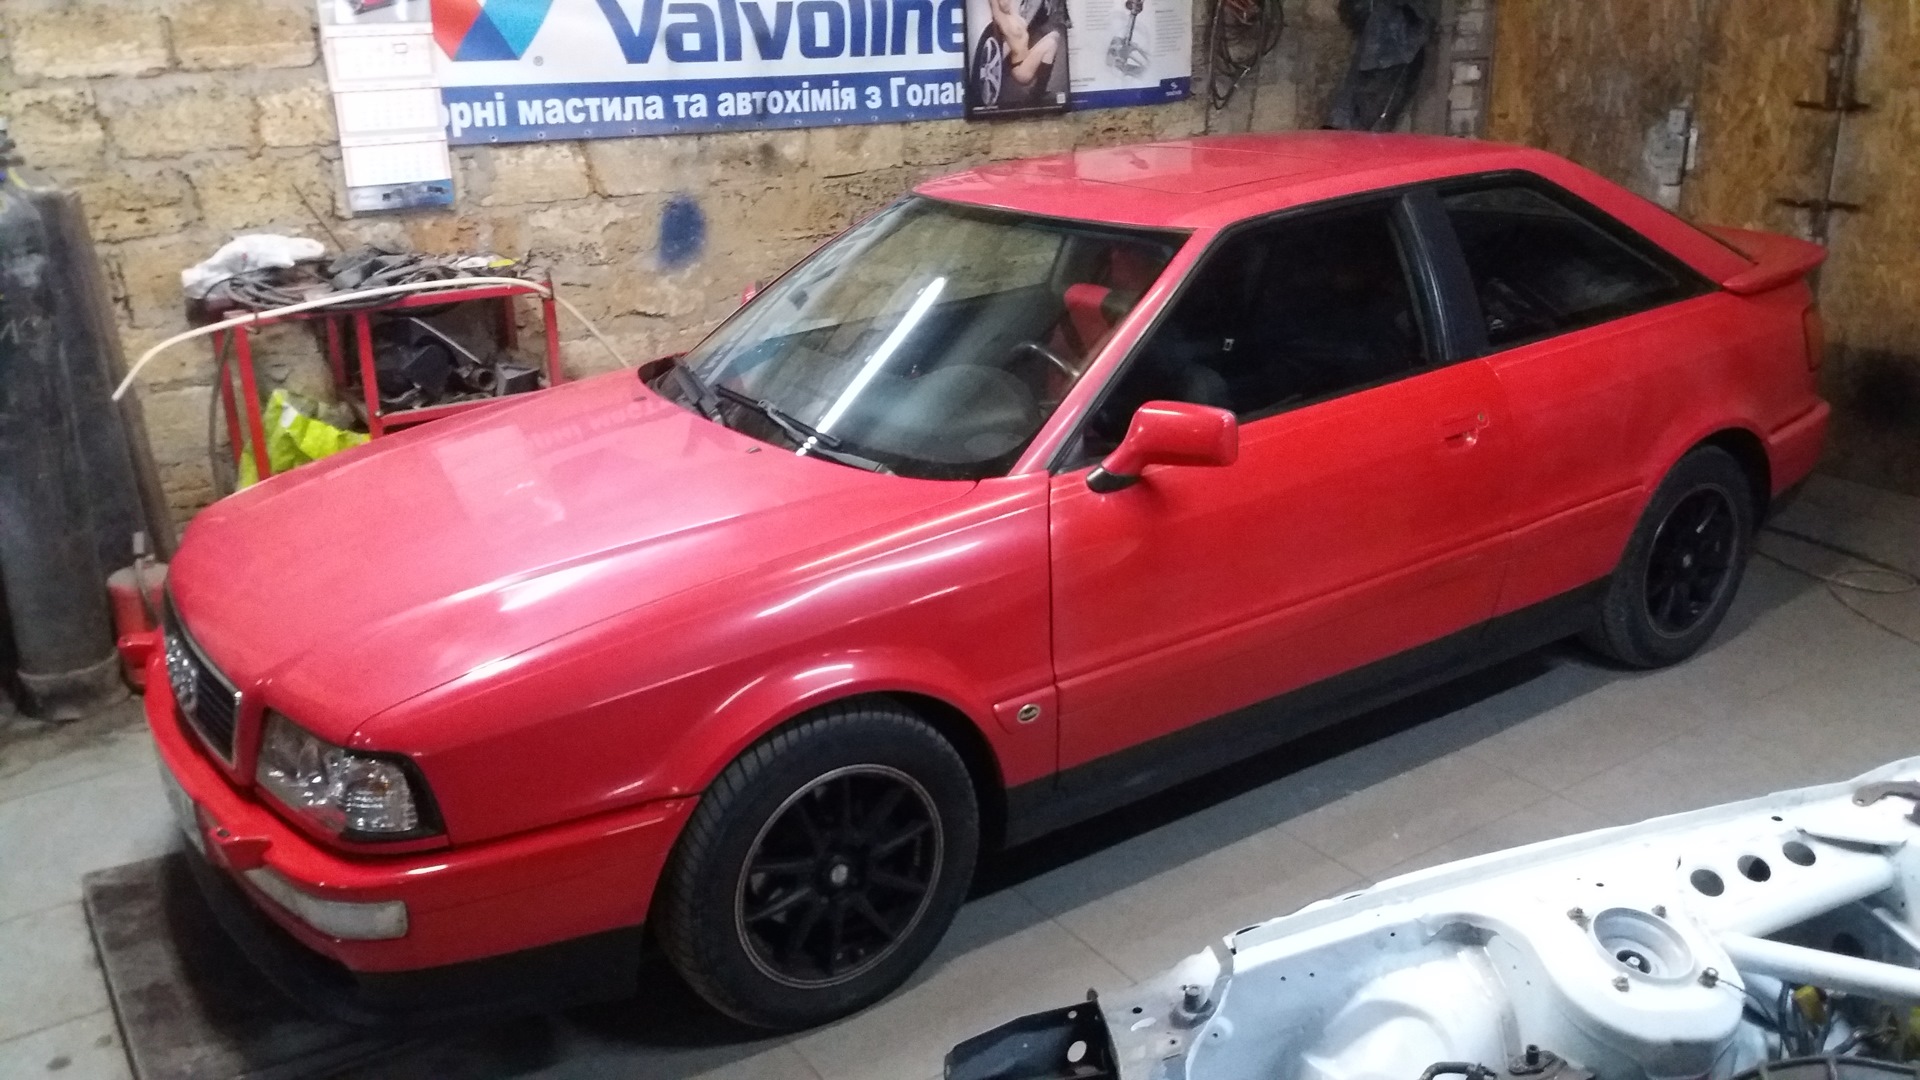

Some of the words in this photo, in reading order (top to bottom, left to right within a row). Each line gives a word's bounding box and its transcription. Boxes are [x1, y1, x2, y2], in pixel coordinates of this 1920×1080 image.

[595, 0, 963, 64] Valvoline
[517, 95, 664, 125] мастила
[673, 93, 708, 118] та
[717, 80, 856, 117] автохімія
[865, 86, 882, 109] з
